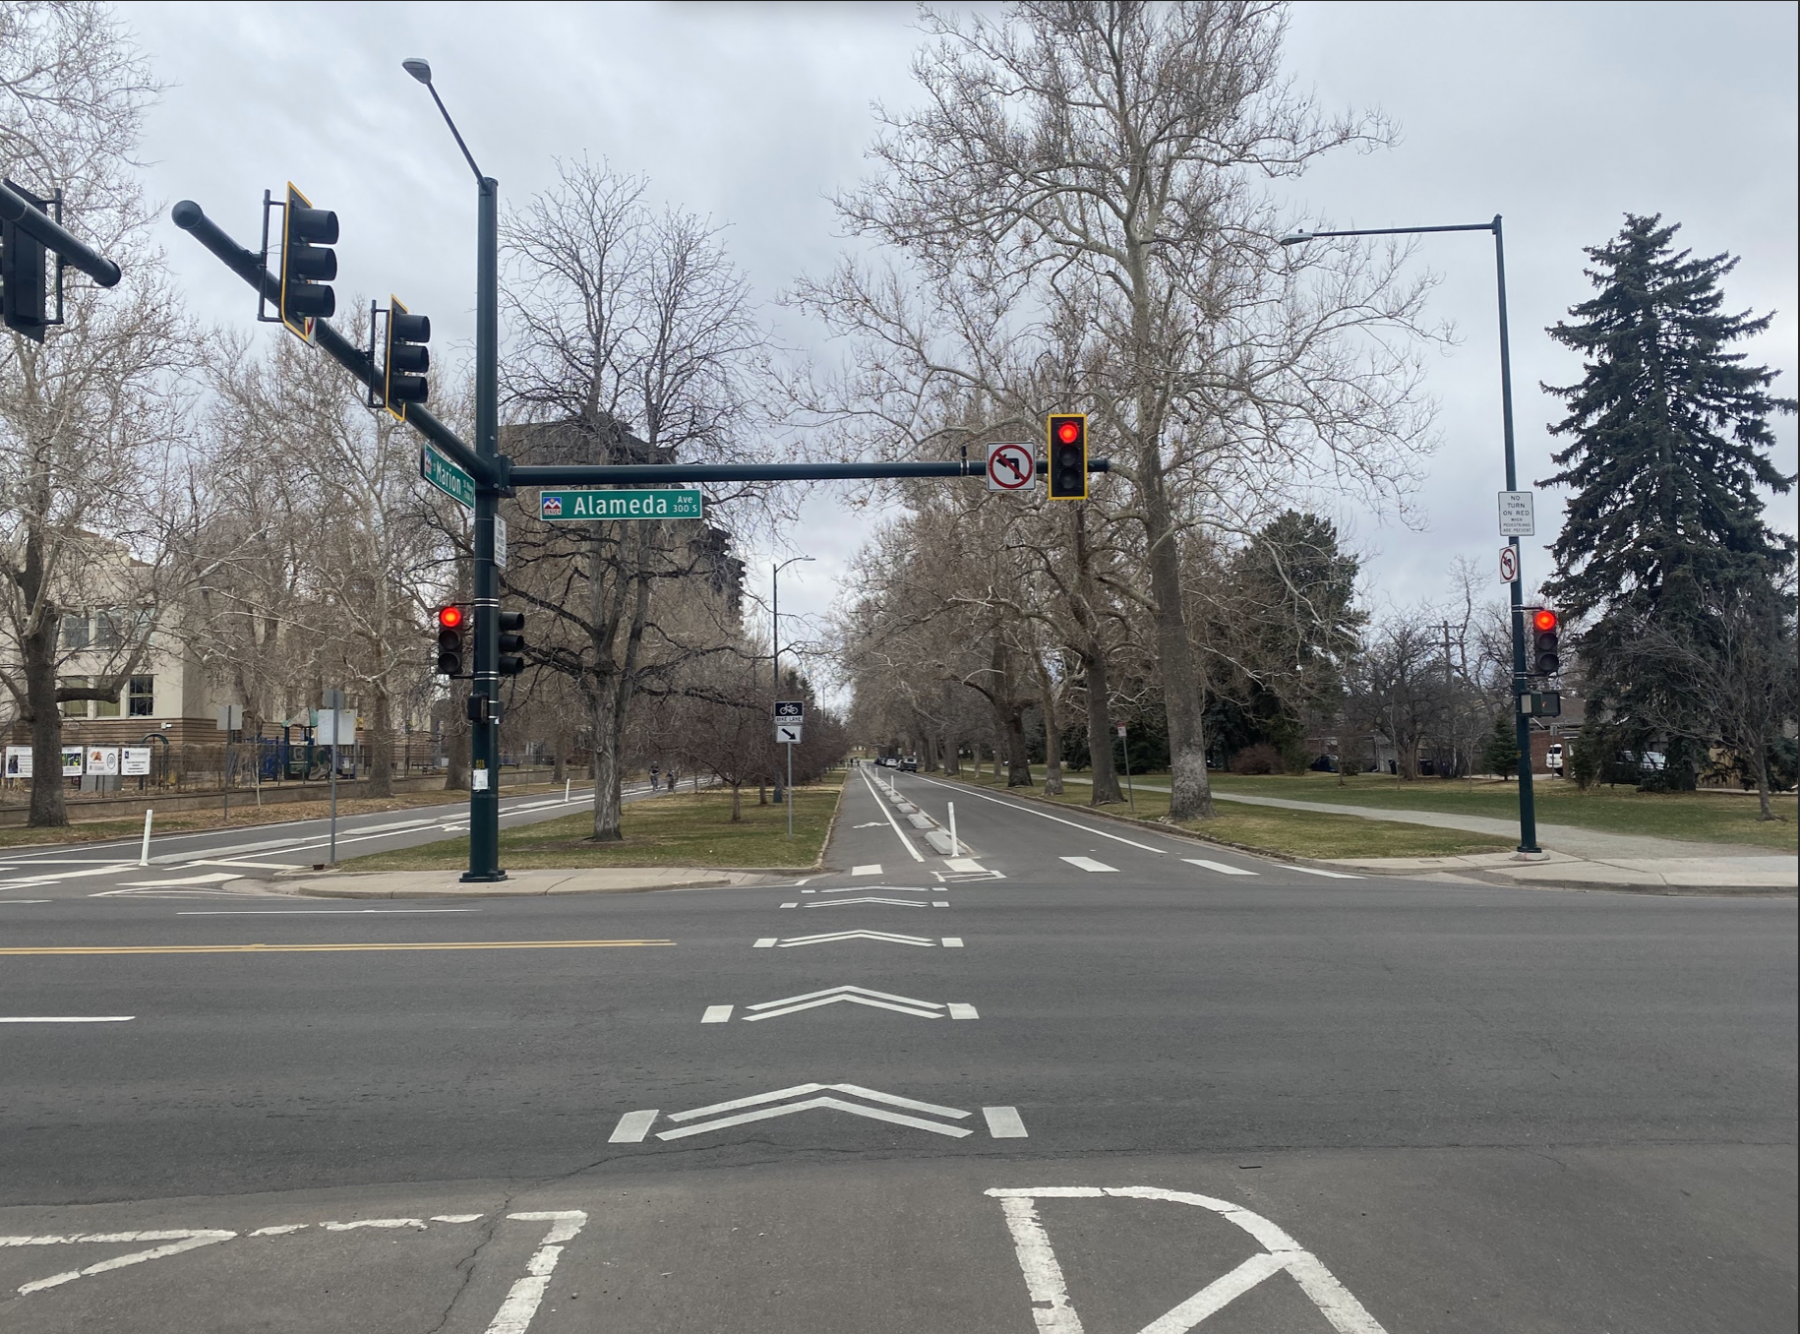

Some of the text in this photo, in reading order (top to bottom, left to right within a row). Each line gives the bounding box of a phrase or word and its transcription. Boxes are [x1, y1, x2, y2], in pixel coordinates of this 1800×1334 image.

[437, 461, 461, 495] Marion
[573, 495, 668, 515] Alameda
[677, 496, 693, 504] Ave
[673, 504, 698, 513] 300 S
